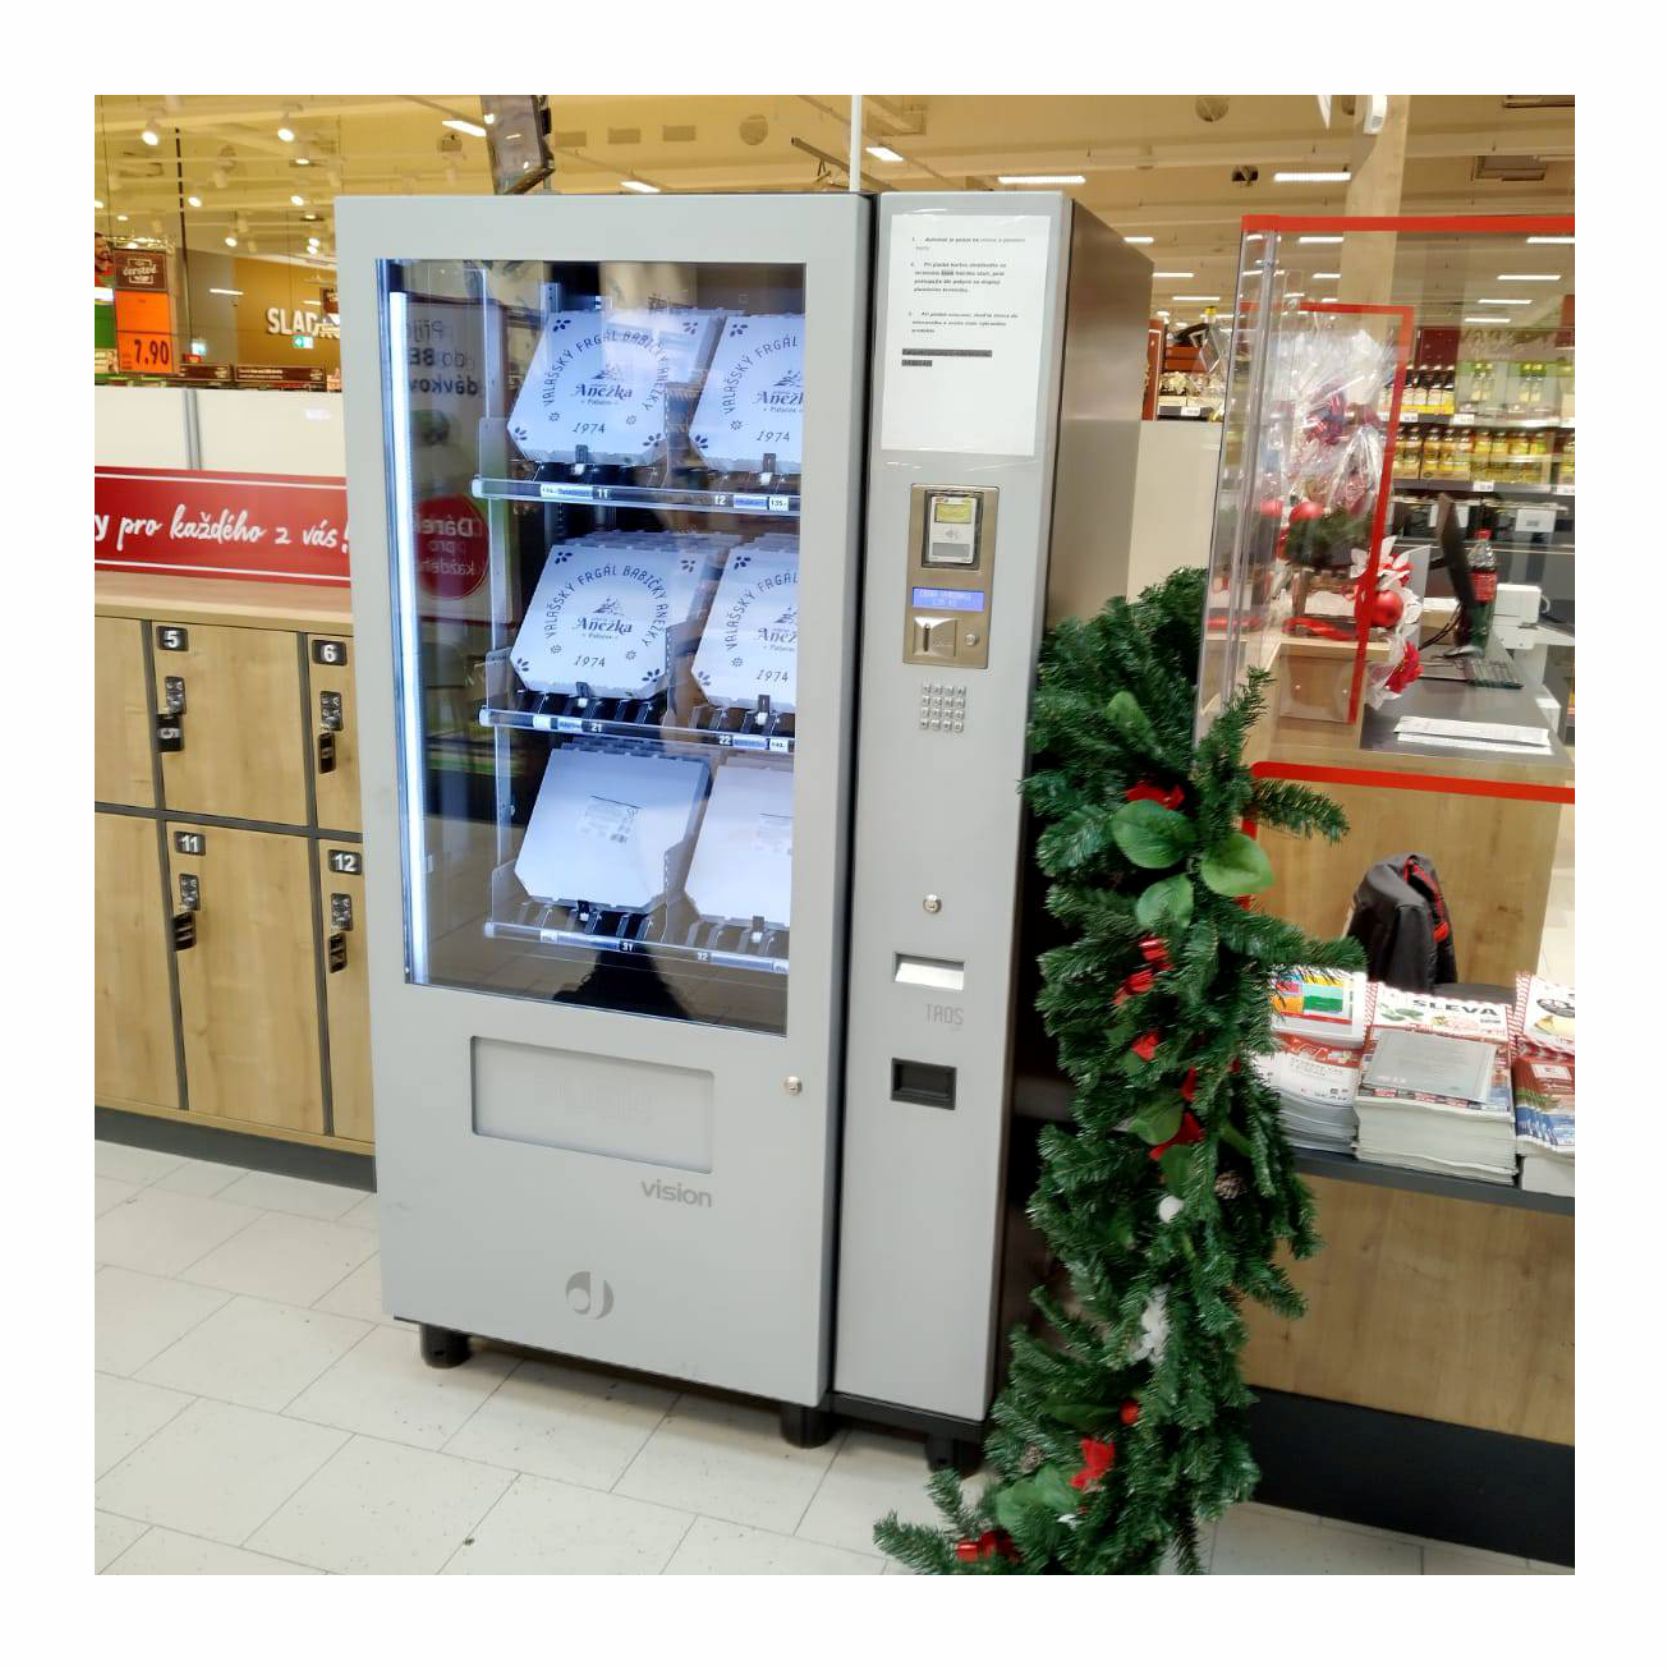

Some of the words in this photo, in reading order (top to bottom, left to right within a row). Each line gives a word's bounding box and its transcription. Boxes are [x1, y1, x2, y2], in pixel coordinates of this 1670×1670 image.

[134, 339, 169, 365] 7.90
[572, 422, 607, 434] 1974
[756, 430, 790, 442] 1974
[116, 516, 162, 552] pro
[170, 503, 267, 544] každého
[274, 527, 292, 545] z
[302, 519, 349, 554] vás!
[164, 629, 180, 648] 5
[323, 643, 337, 662] 6
[573, 655, 606, 667] 1974
[756, 669, 789, 682] 1974
[181, 835, 199, 853] 11
[334, 853, 356, 872] 12
[1412, 999, 1499, 1016] SLEVA
[641, 1179, 712, 1209] vision
